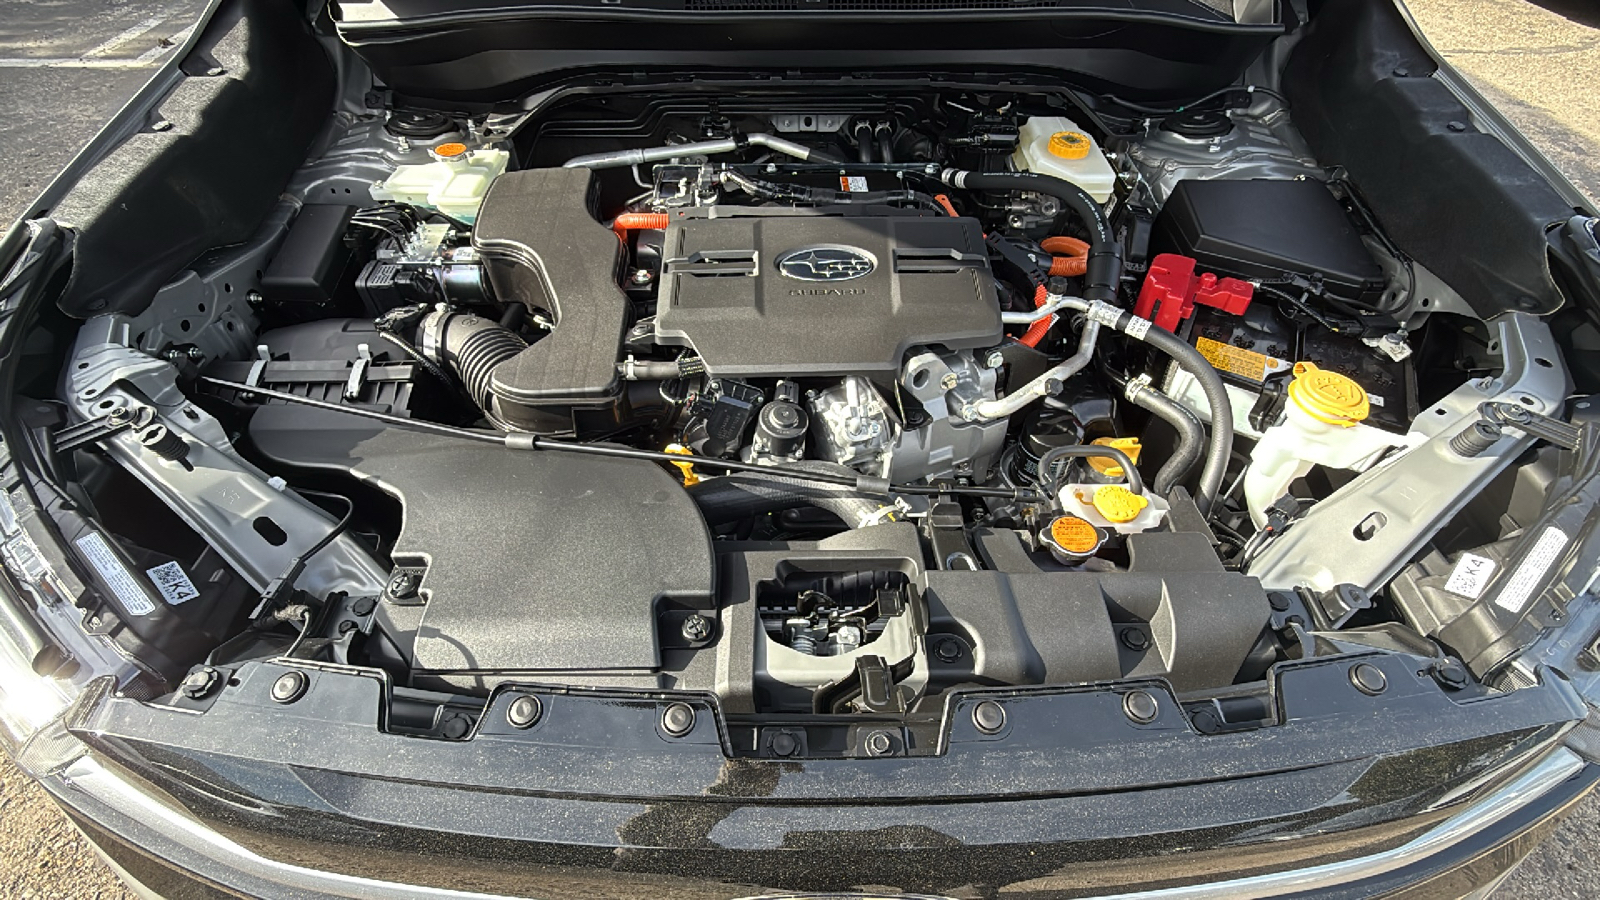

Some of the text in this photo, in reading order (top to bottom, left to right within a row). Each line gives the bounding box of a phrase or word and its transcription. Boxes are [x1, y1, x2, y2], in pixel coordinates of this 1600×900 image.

[788, 288, 867, 297] SUBARU
[1464, 558, 1485, 576] K4
[168, 581, 191, 600] K4
